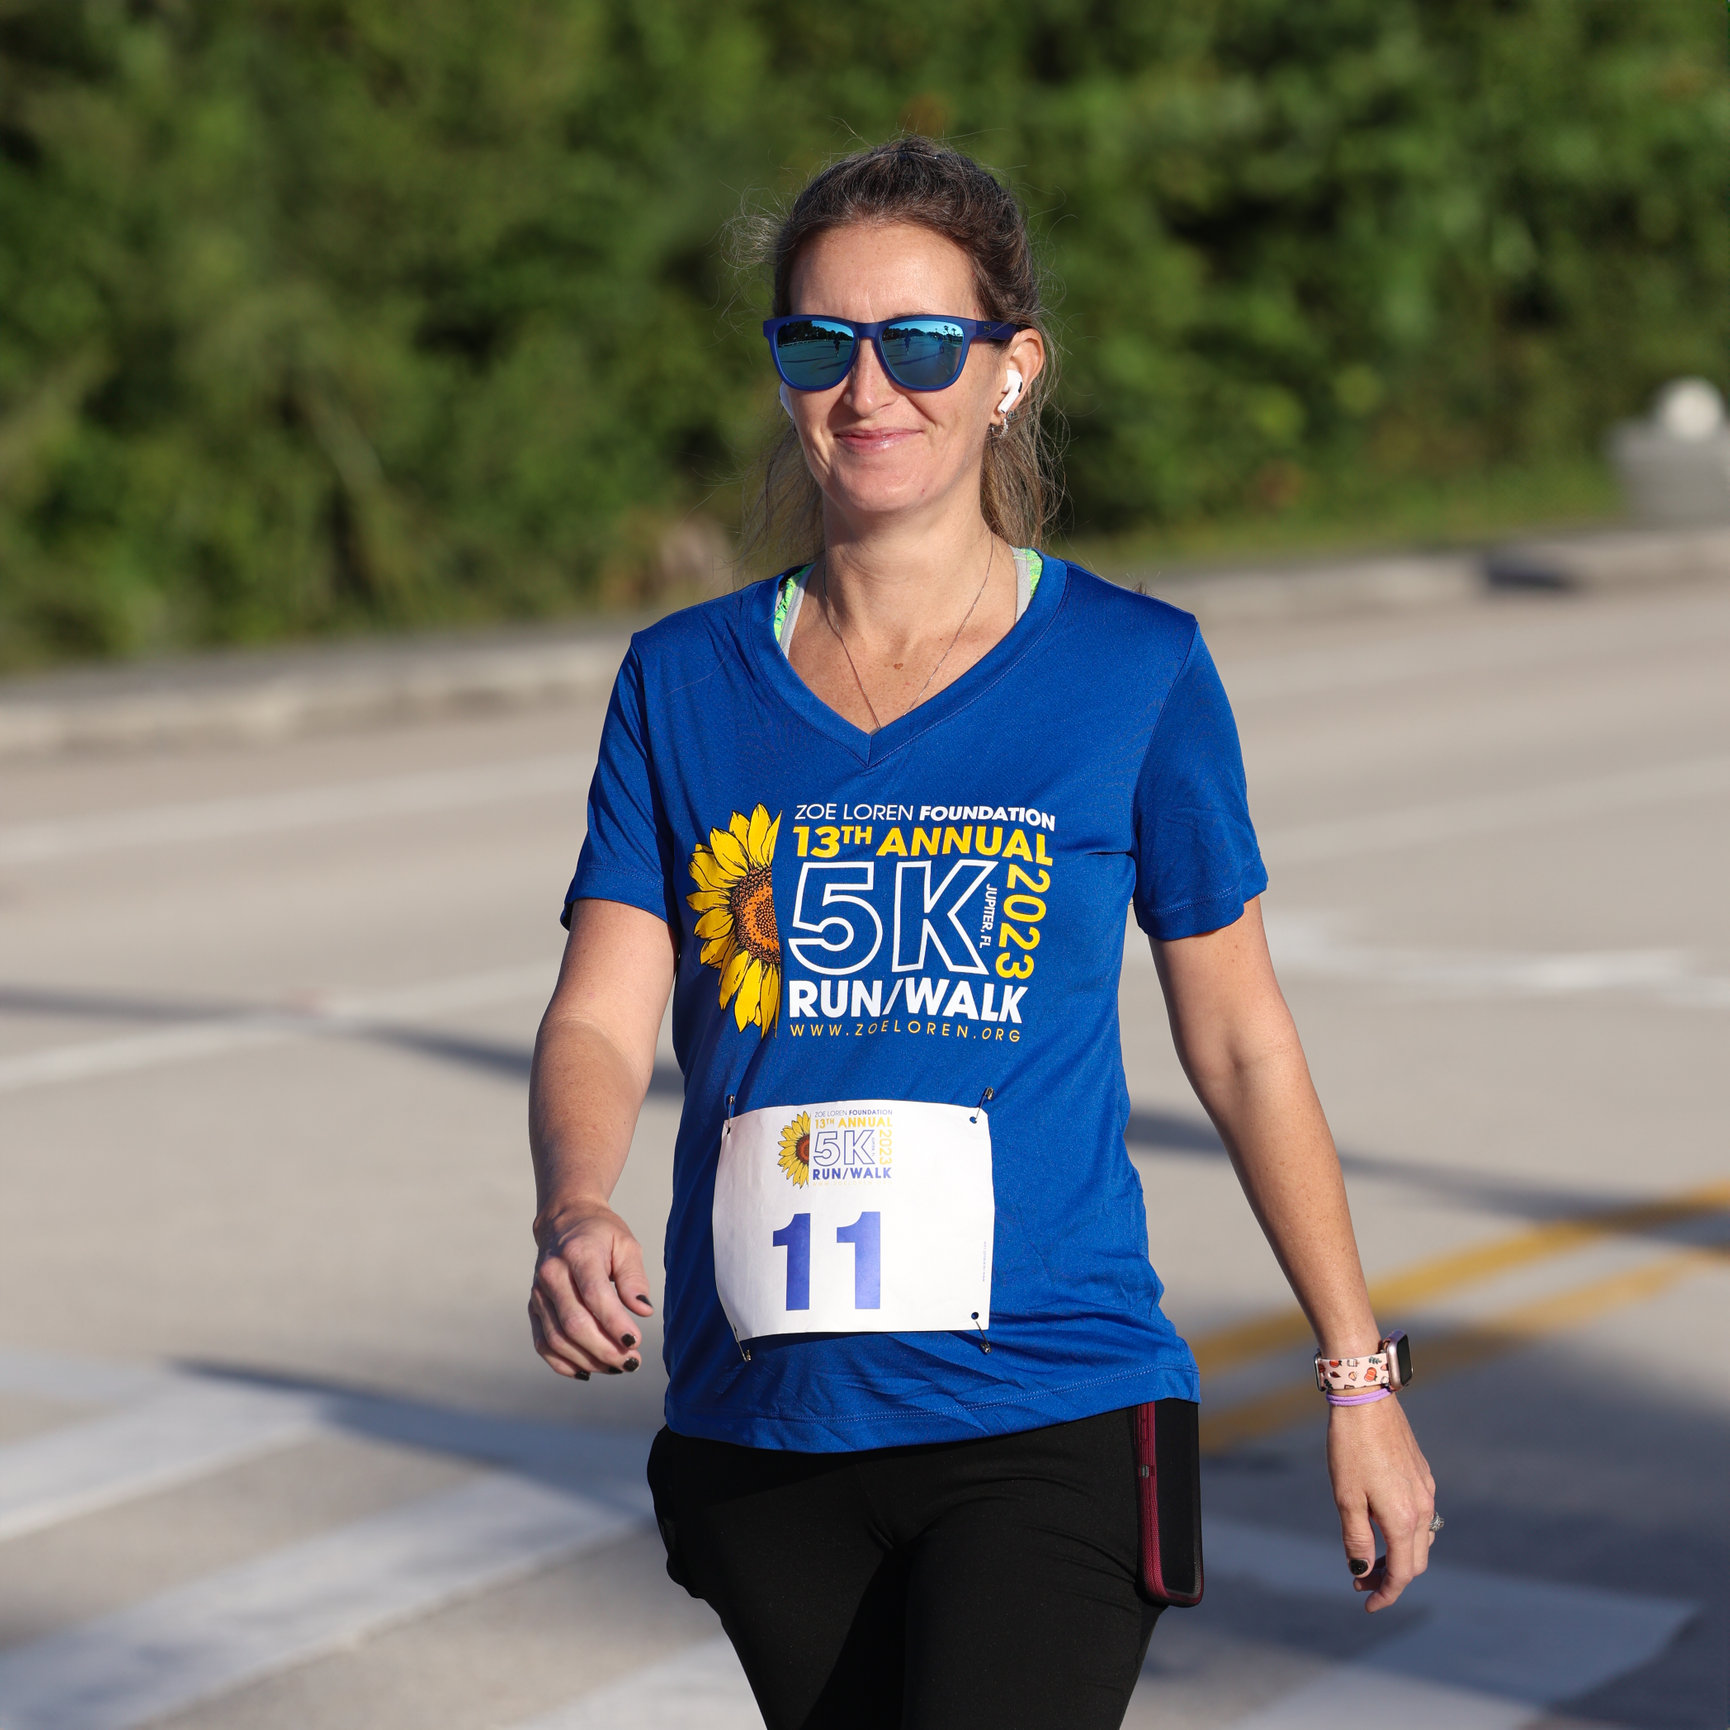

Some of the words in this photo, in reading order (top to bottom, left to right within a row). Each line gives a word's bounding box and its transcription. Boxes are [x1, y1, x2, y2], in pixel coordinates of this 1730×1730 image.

[795, 804, 837, 820] ZOE
[843, 804, 915, 821] LOREN
[919, 805, 1056, 832] FOUNDATION
[793, 825, 873, 858] 13TH
[876, 825, 1054, 867] ANNUAL
[788, 859, 999, 976] 5K
[982, 883, 998, 934] JUPITER,
[995, 863, 1052, 979] 2023
[979, 934, 993, 949] FL
[789, 977, 1029, 1024] RUN/WALK
[791, 1020, 1021, 1042] WWW.ZOELOREN.ORG
[815, 1118, 835, 1129] 13TH
[838, 1116, 893, 1128] ANNUAL
[813, 1129, 876, 1167] 5K
[879, 1129, 893, 1165] 2023
[813, 1167, 892, 1180] RUN/WALK
[772, 1211, 881, 1311] 11
